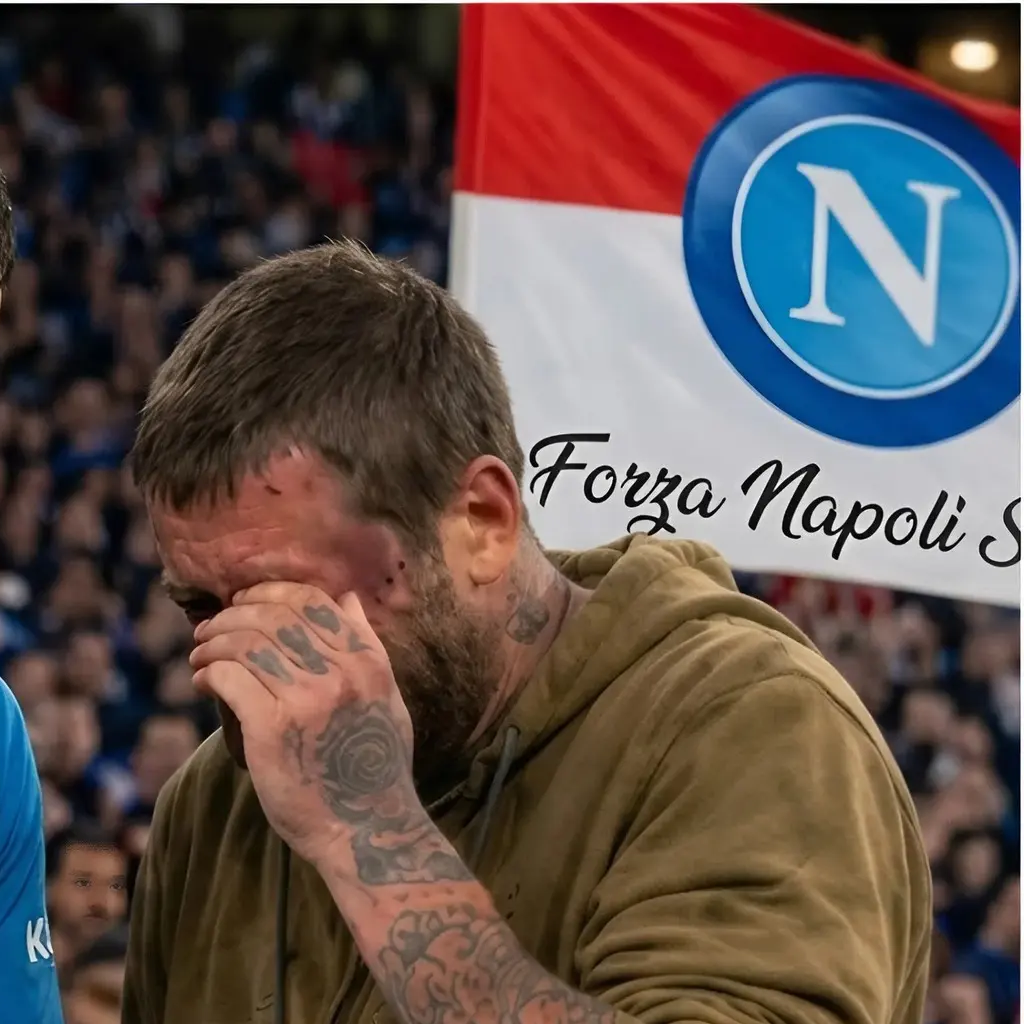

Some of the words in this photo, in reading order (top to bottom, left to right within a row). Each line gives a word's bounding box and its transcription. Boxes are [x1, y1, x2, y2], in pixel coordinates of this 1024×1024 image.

[789, 162, 961, 347] N
[528, 432, 727, 535] Forza
[740, 458, 966, 561] Napoli
